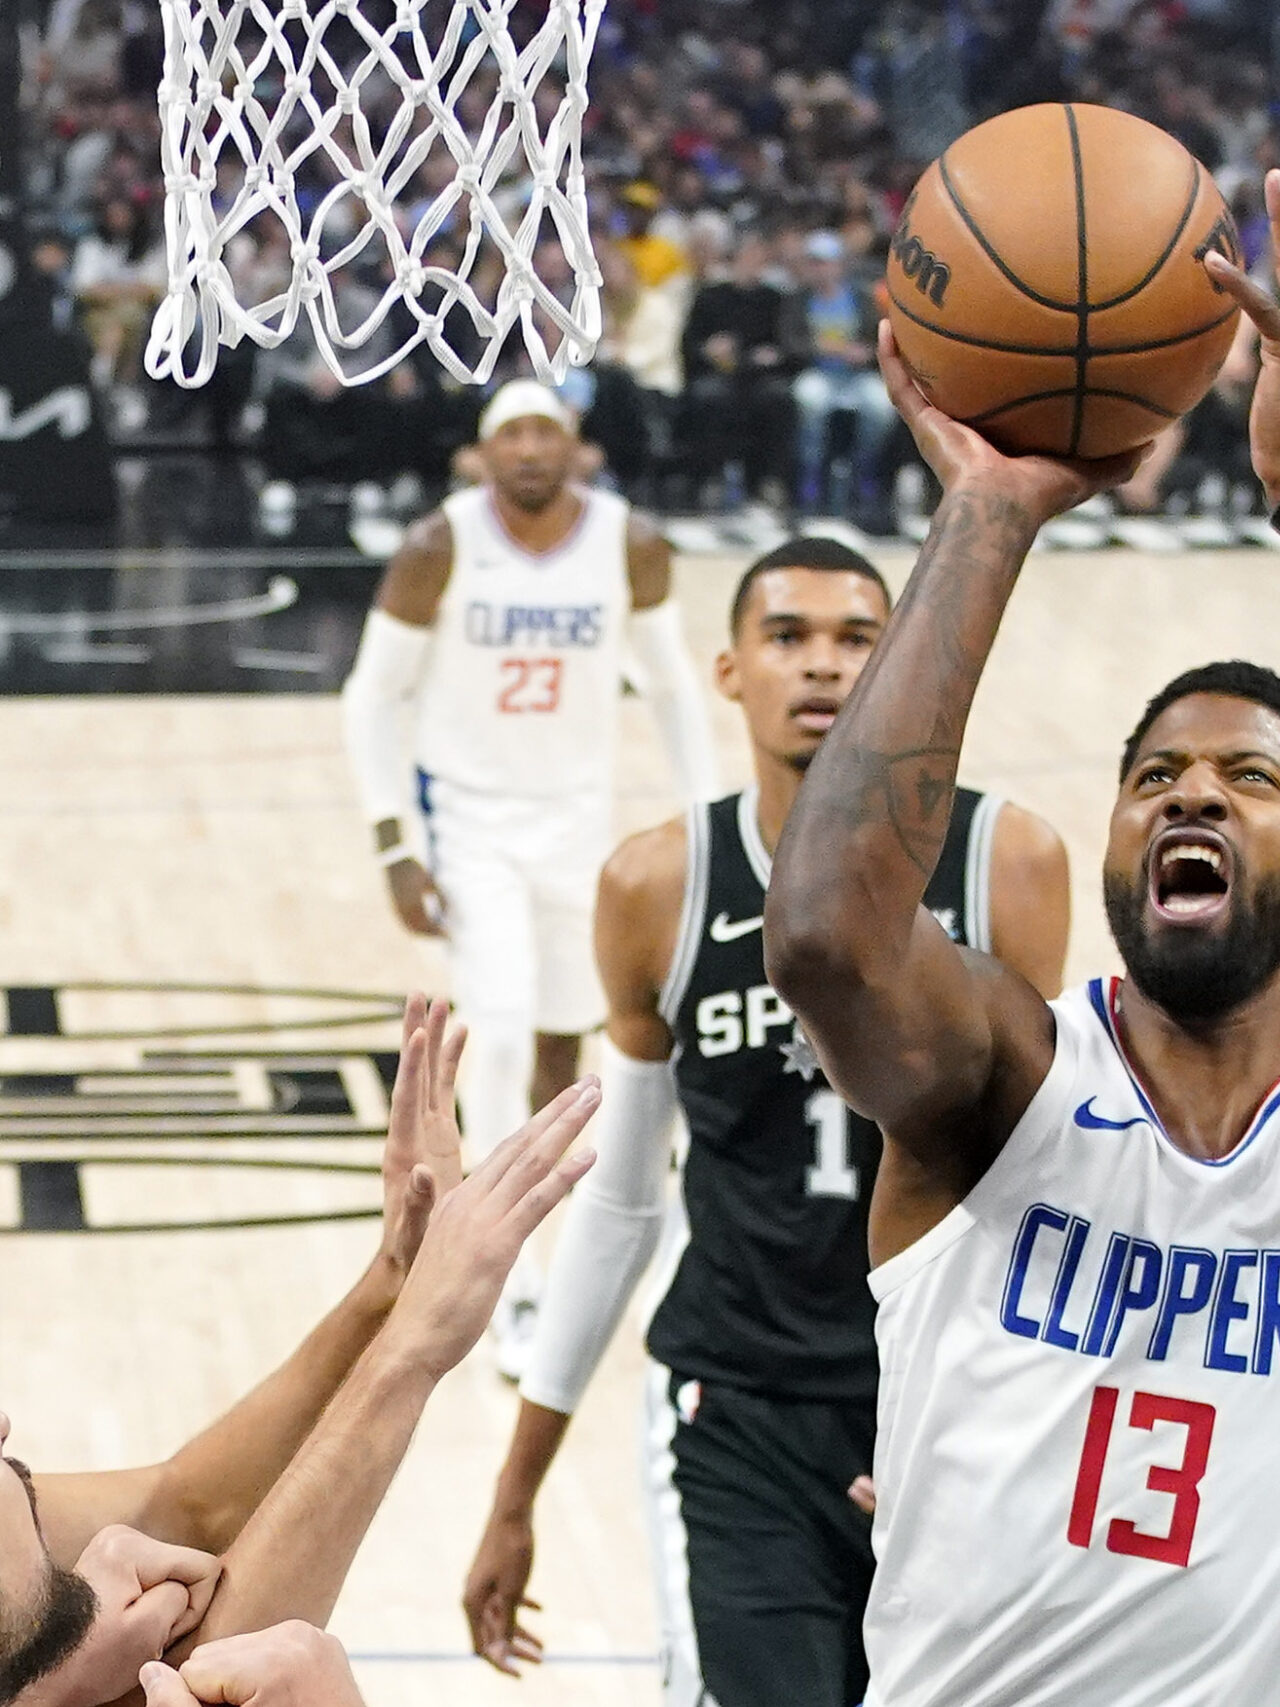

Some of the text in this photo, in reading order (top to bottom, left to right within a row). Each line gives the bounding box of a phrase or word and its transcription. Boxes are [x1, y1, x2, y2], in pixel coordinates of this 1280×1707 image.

[467, 600, 602, 648] CLIPPERS
[498, 657, 562, 713] 23
[804, 1088, 858, 1198] 1
[1067, 1385, 1217, 1568] 13
